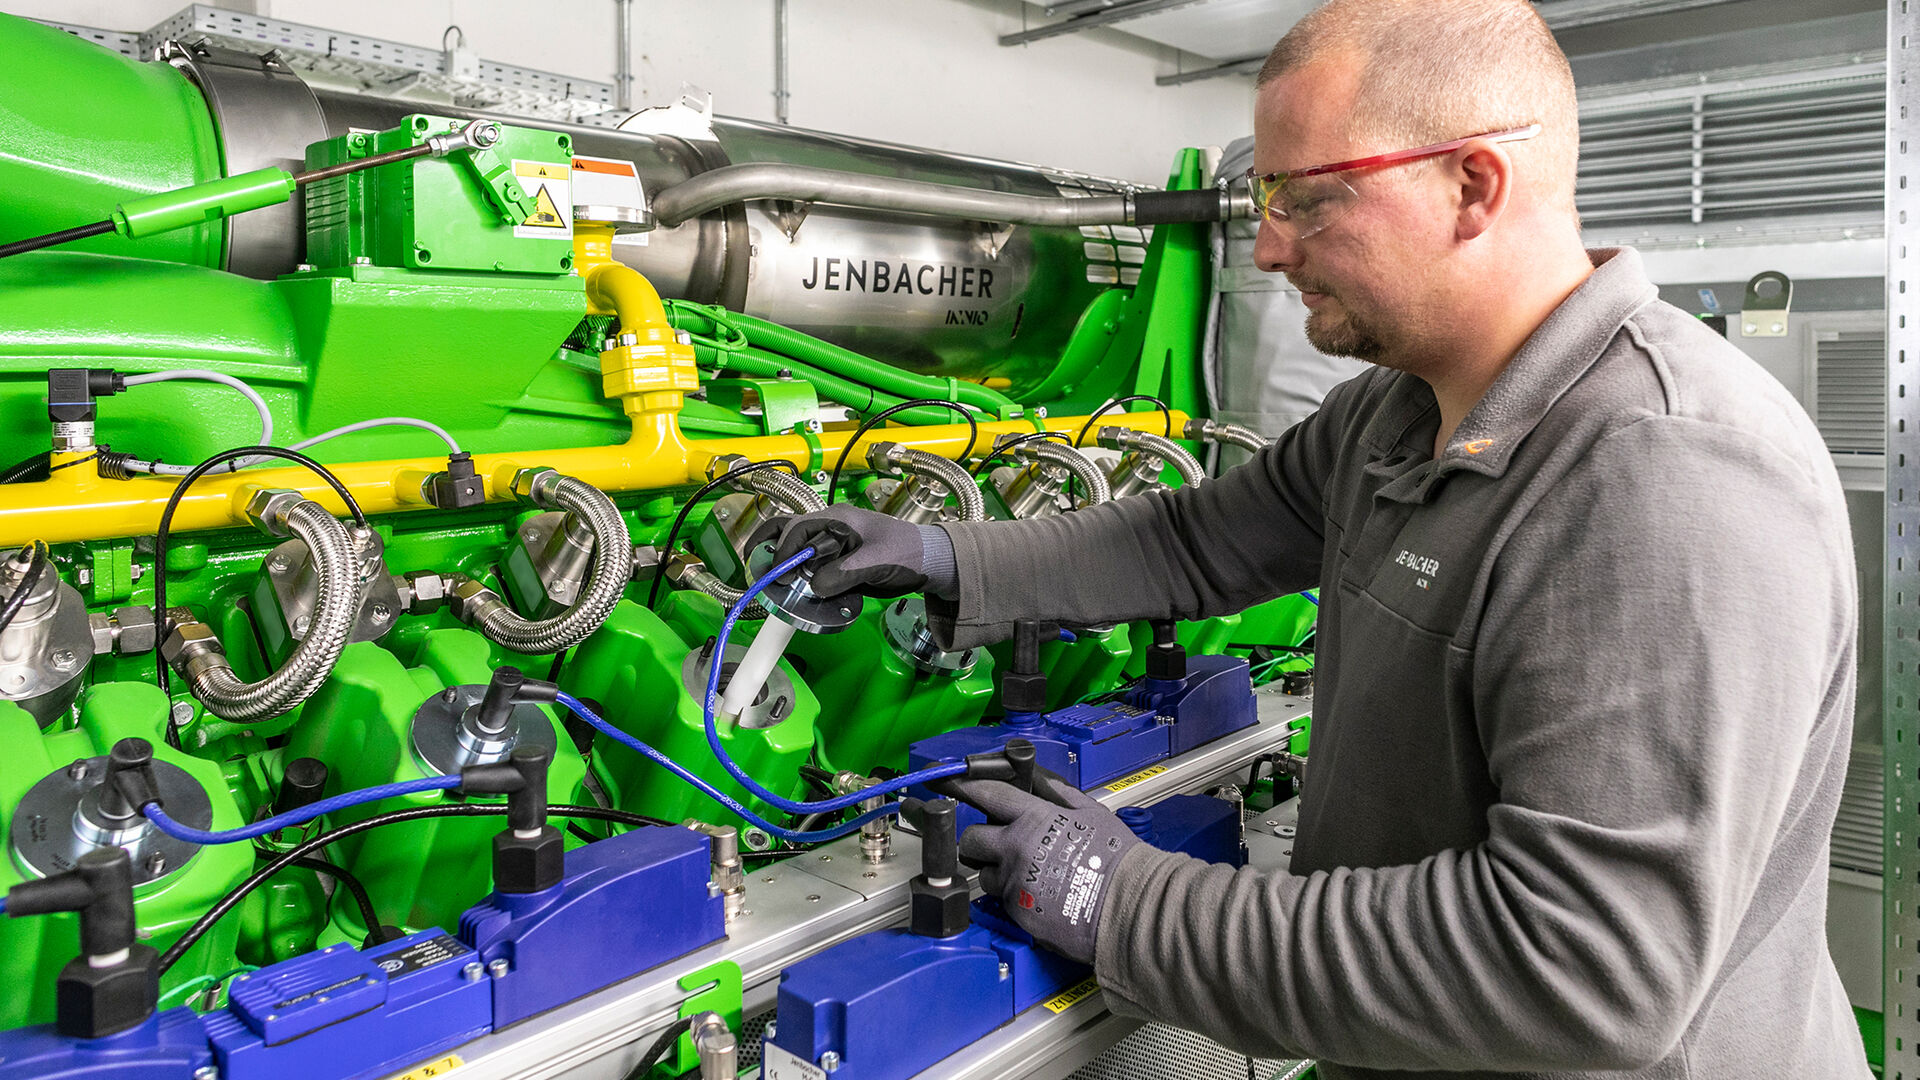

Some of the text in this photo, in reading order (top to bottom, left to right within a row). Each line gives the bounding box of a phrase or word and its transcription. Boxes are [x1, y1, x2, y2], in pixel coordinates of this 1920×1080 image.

[803, 257, 993, 298] JENBACHER
[1395, 550, 1439, 577] JEBACHER
[1026, 814, 1069, 882] WÜRTH
[1071, 885, 1088, 926] STANDARD
